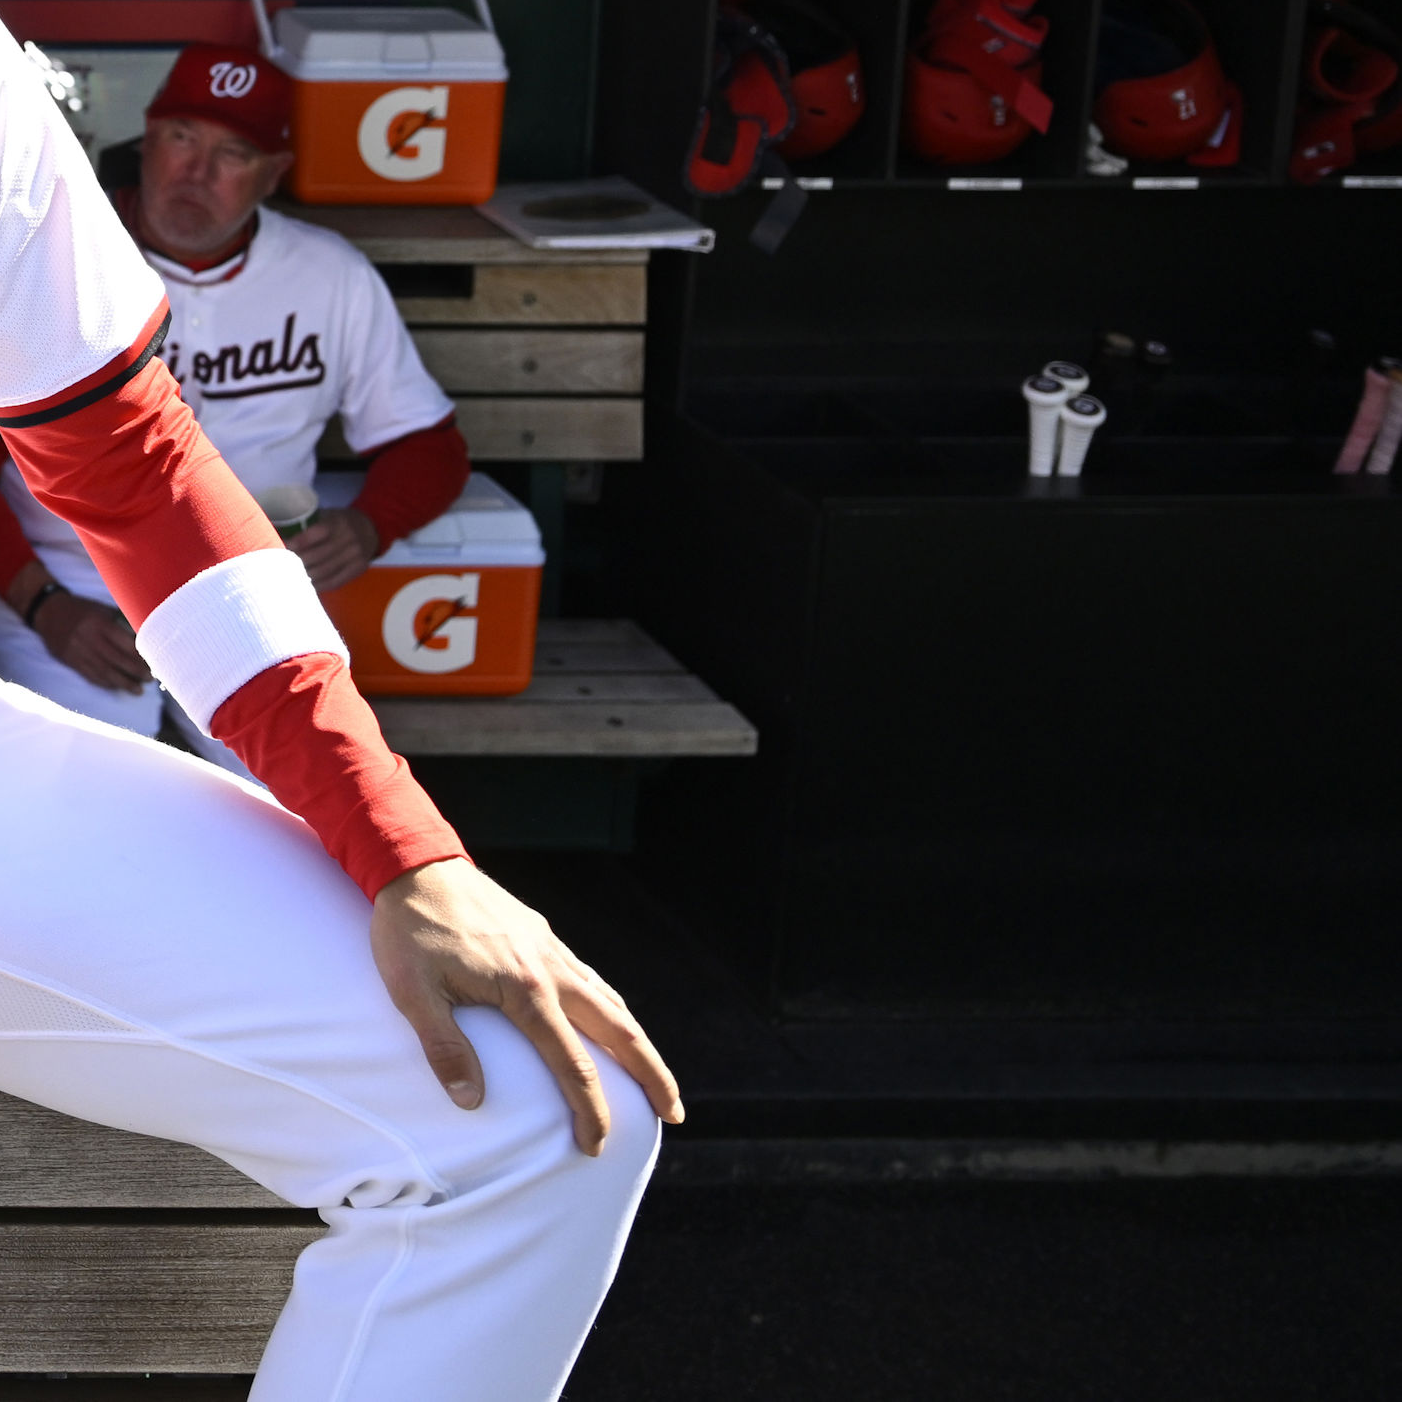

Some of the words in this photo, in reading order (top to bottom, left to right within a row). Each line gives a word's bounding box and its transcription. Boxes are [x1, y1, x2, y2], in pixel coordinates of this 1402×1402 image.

[358, 86, 449, 182] G
[155, 312, 323, 385] ionals
[382, 573, 480, 674] G
